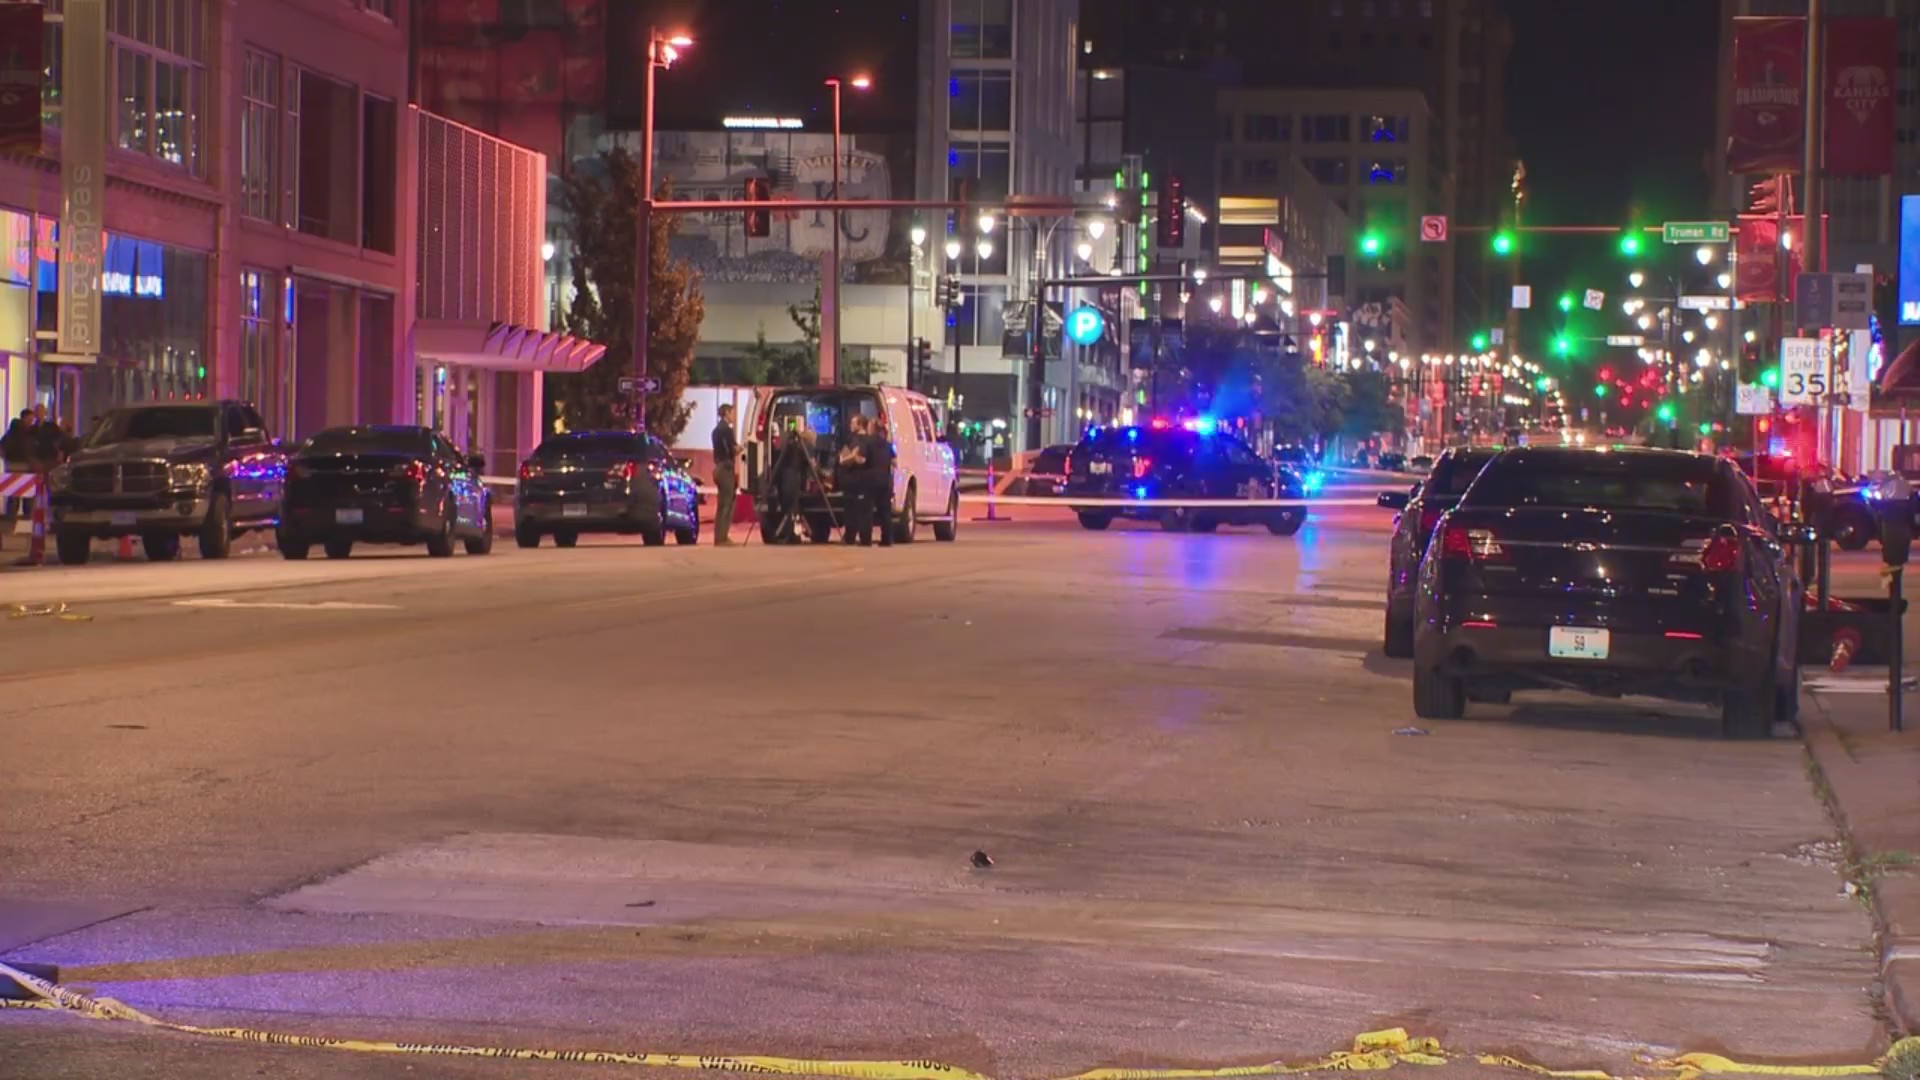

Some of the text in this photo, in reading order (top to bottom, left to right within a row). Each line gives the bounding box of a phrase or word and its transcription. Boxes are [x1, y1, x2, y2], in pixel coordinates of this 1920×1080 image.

[1834, 87, 1890, 98] KANSAS
[1846, 99, 1878, 110] CITY
[1670, 226, 1724, 238] Truman Rd
[1076, 312, 1098, 338] P
[1787, 345, 1829, 358] SPEED
[1790, 360, 1824, 370] LIMIT
[1788, 373, 1825, 396] 35
